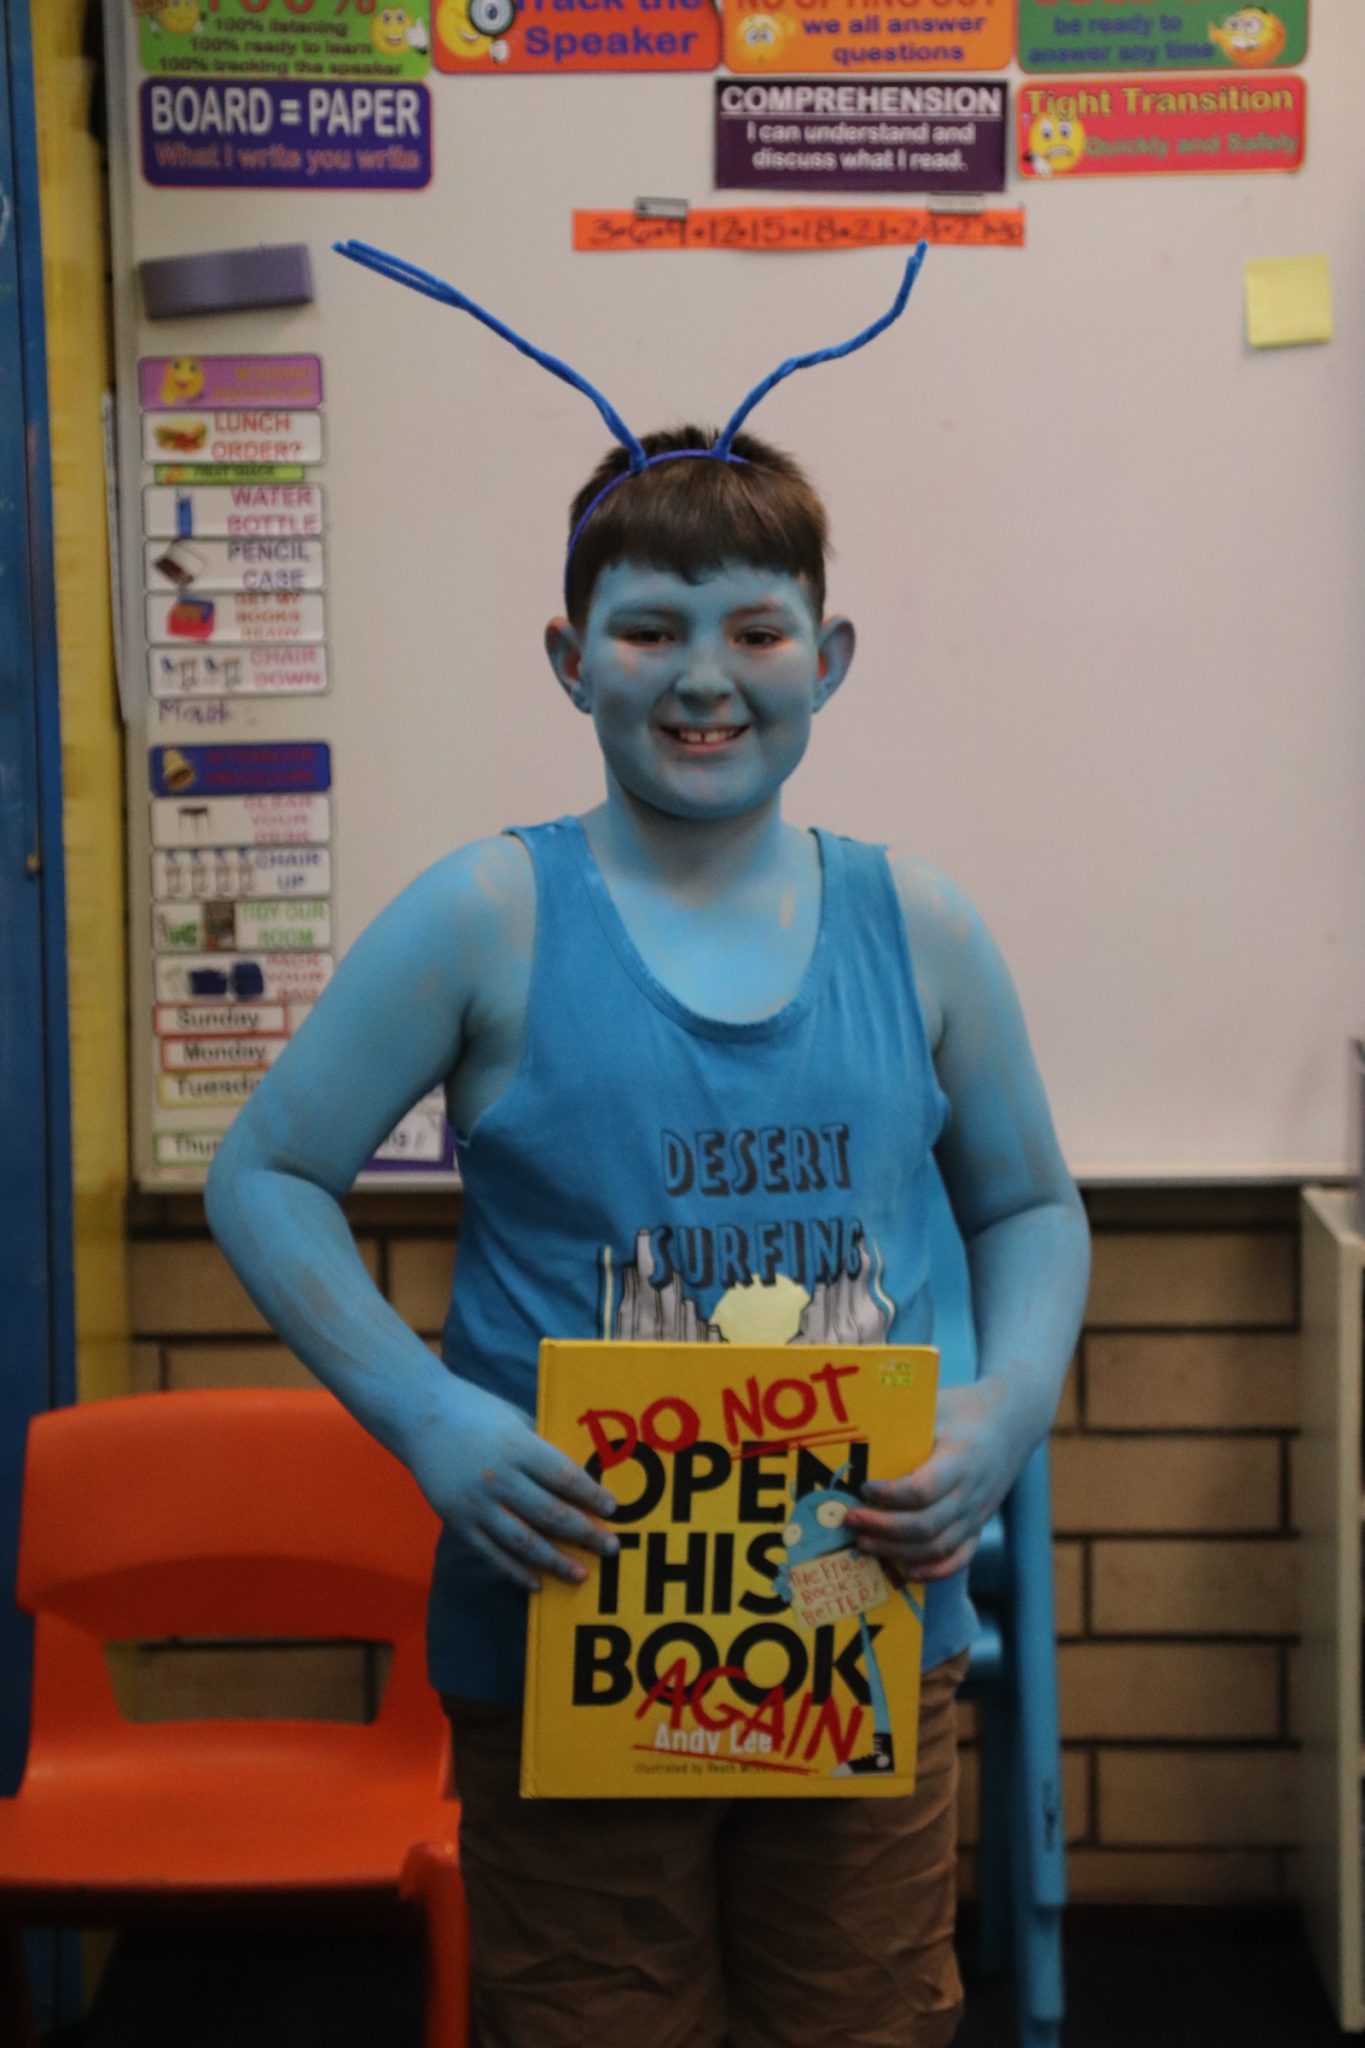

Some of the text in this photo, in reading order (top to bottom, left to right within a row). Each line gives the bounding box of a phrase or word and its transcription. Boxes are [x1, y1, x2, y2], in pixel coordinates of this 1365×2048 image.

[216, 17, 348, 38] 100% listening
[802, 14, 987, 34] we all answer
[190, 37, 239, 52] 100%
[524, 25, 698, 63] Speaker
[832, 44, 965, 65] questions
[150, 86, 420, 137] BOARD = PAPER
[720, 86, 1002, 114] COMPREHENSION
[1025, 85, 1294, 124] Tight Transition
[746, 122, 976, 145] I can understand and
[1084, 131, 1297, 160] Quickly and Safely
[154, 142, 222, 169] What
[239, 142, 300, 169] write
[306, 148, 351, 174] you
[357, 144, 420, 170] write
[752, 148, 837, 170] discuss
[840, 149, 896, 170] what
[909, 150, 968, 172] read.
[214, 411, 292, 433] LUNCH
[211, 440, 302, 463] ORDER?
[231, 486, 313, 507] WATER
[227, 515, 318, 534] BOTTLE
[227, 541, 310, 562] PENCIL
[243, 569, 305, 590] CASE
[250, 646, 316, 664] CHAIR
[254, 672, 321, 686] DOWN
[255, 852, 320, 868] CHAIR
[276, 874, 305, 891] UP
[176, 1005, 260, 1030] Sunday
[182, 1041, 267, 1065] Monday
[173, 1074, 261, 1097] Tuesda
[173, 1134, 217, 1155] Thur
[660, 1122, 851, 1197] DESERT
[650, 1216, 864, 1290] SURFING
[577, 1361, 860, 1471] DO NOT
[584, 1438, 870, 1525] OPEN
[594, 1532, 792, 1617] THIS
[572, 1621, 886, 1708] BOOK
[634, 1657, 864, 1764] AGAIN
[654, 1722, 773, 1756] Andy Lee
